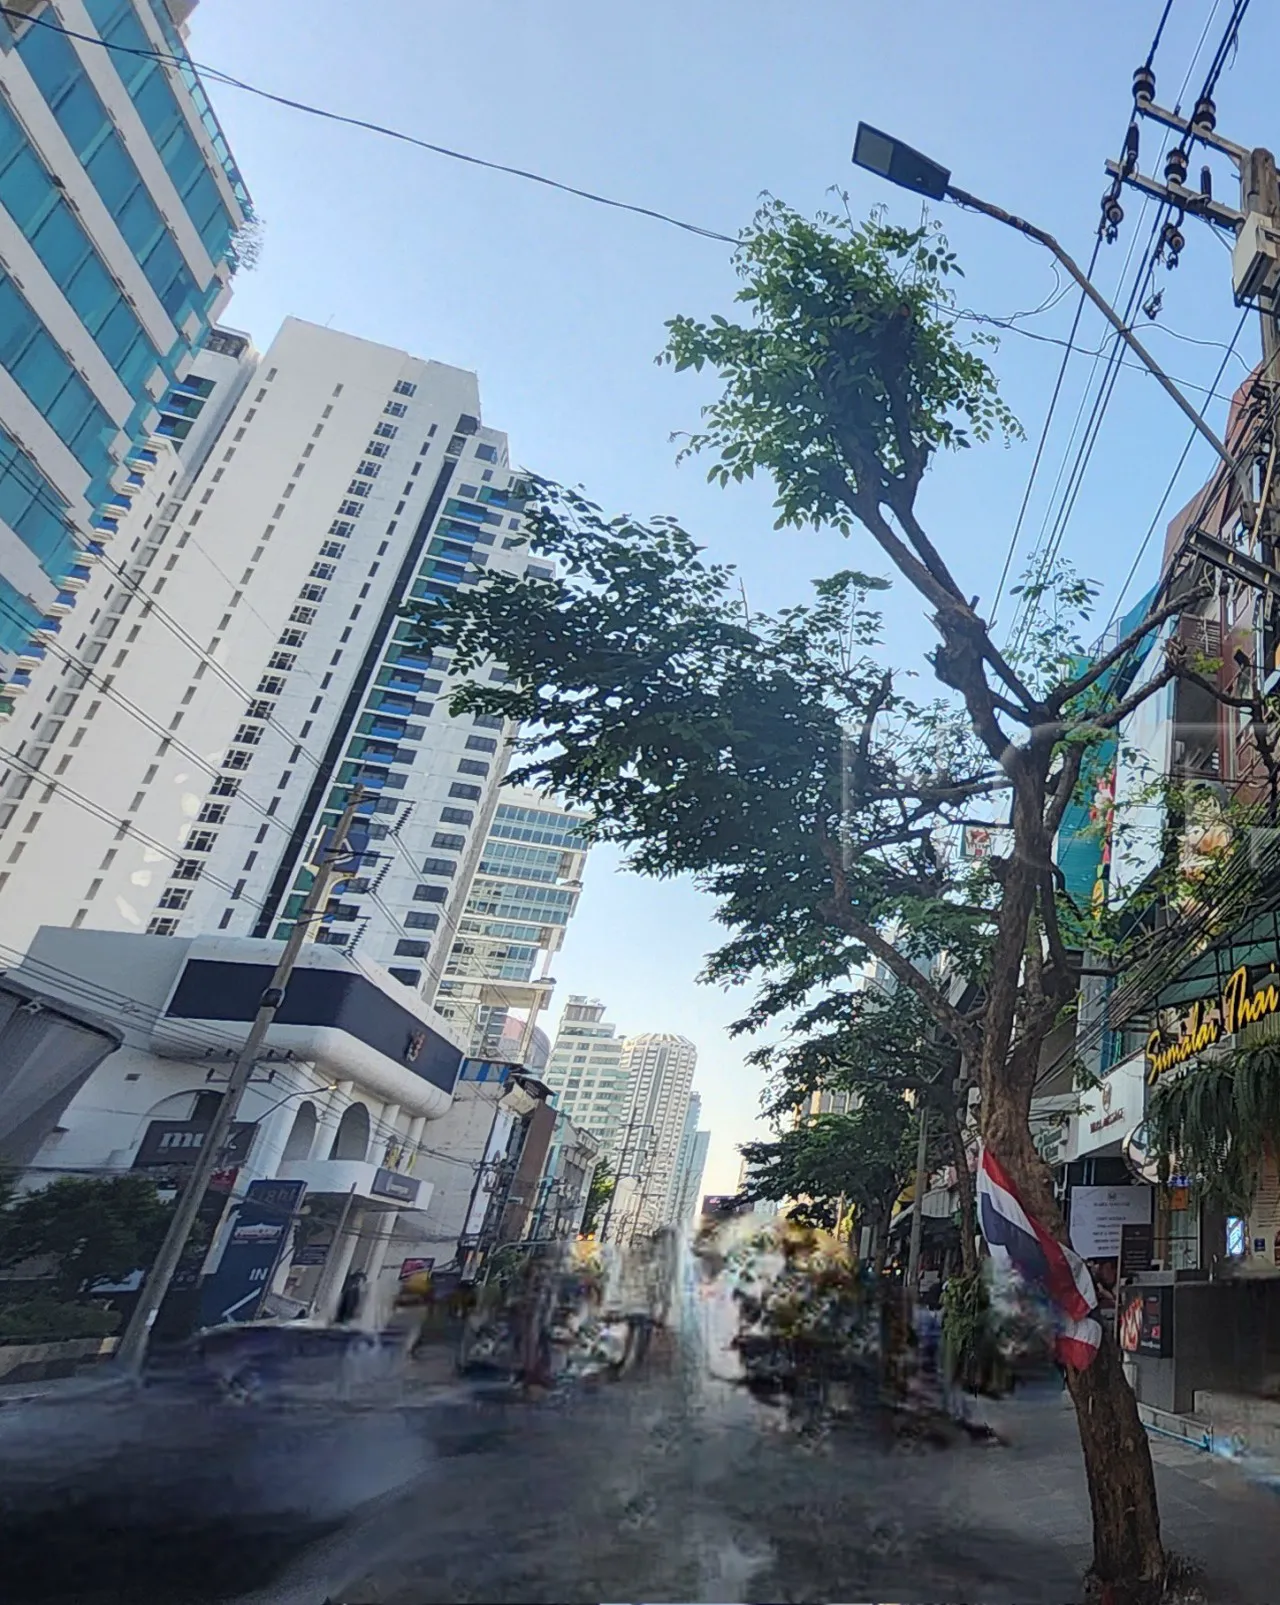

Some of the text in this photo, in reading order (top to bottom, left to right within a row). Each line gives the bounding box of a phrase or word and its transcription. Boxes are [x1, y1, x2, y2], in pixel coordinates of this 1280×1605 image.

[1145, 1001, 1218, 1085] Sumalai
[1222, 963, 1280, 1034] Thai
[249, 1267, 268, 1281] IN
